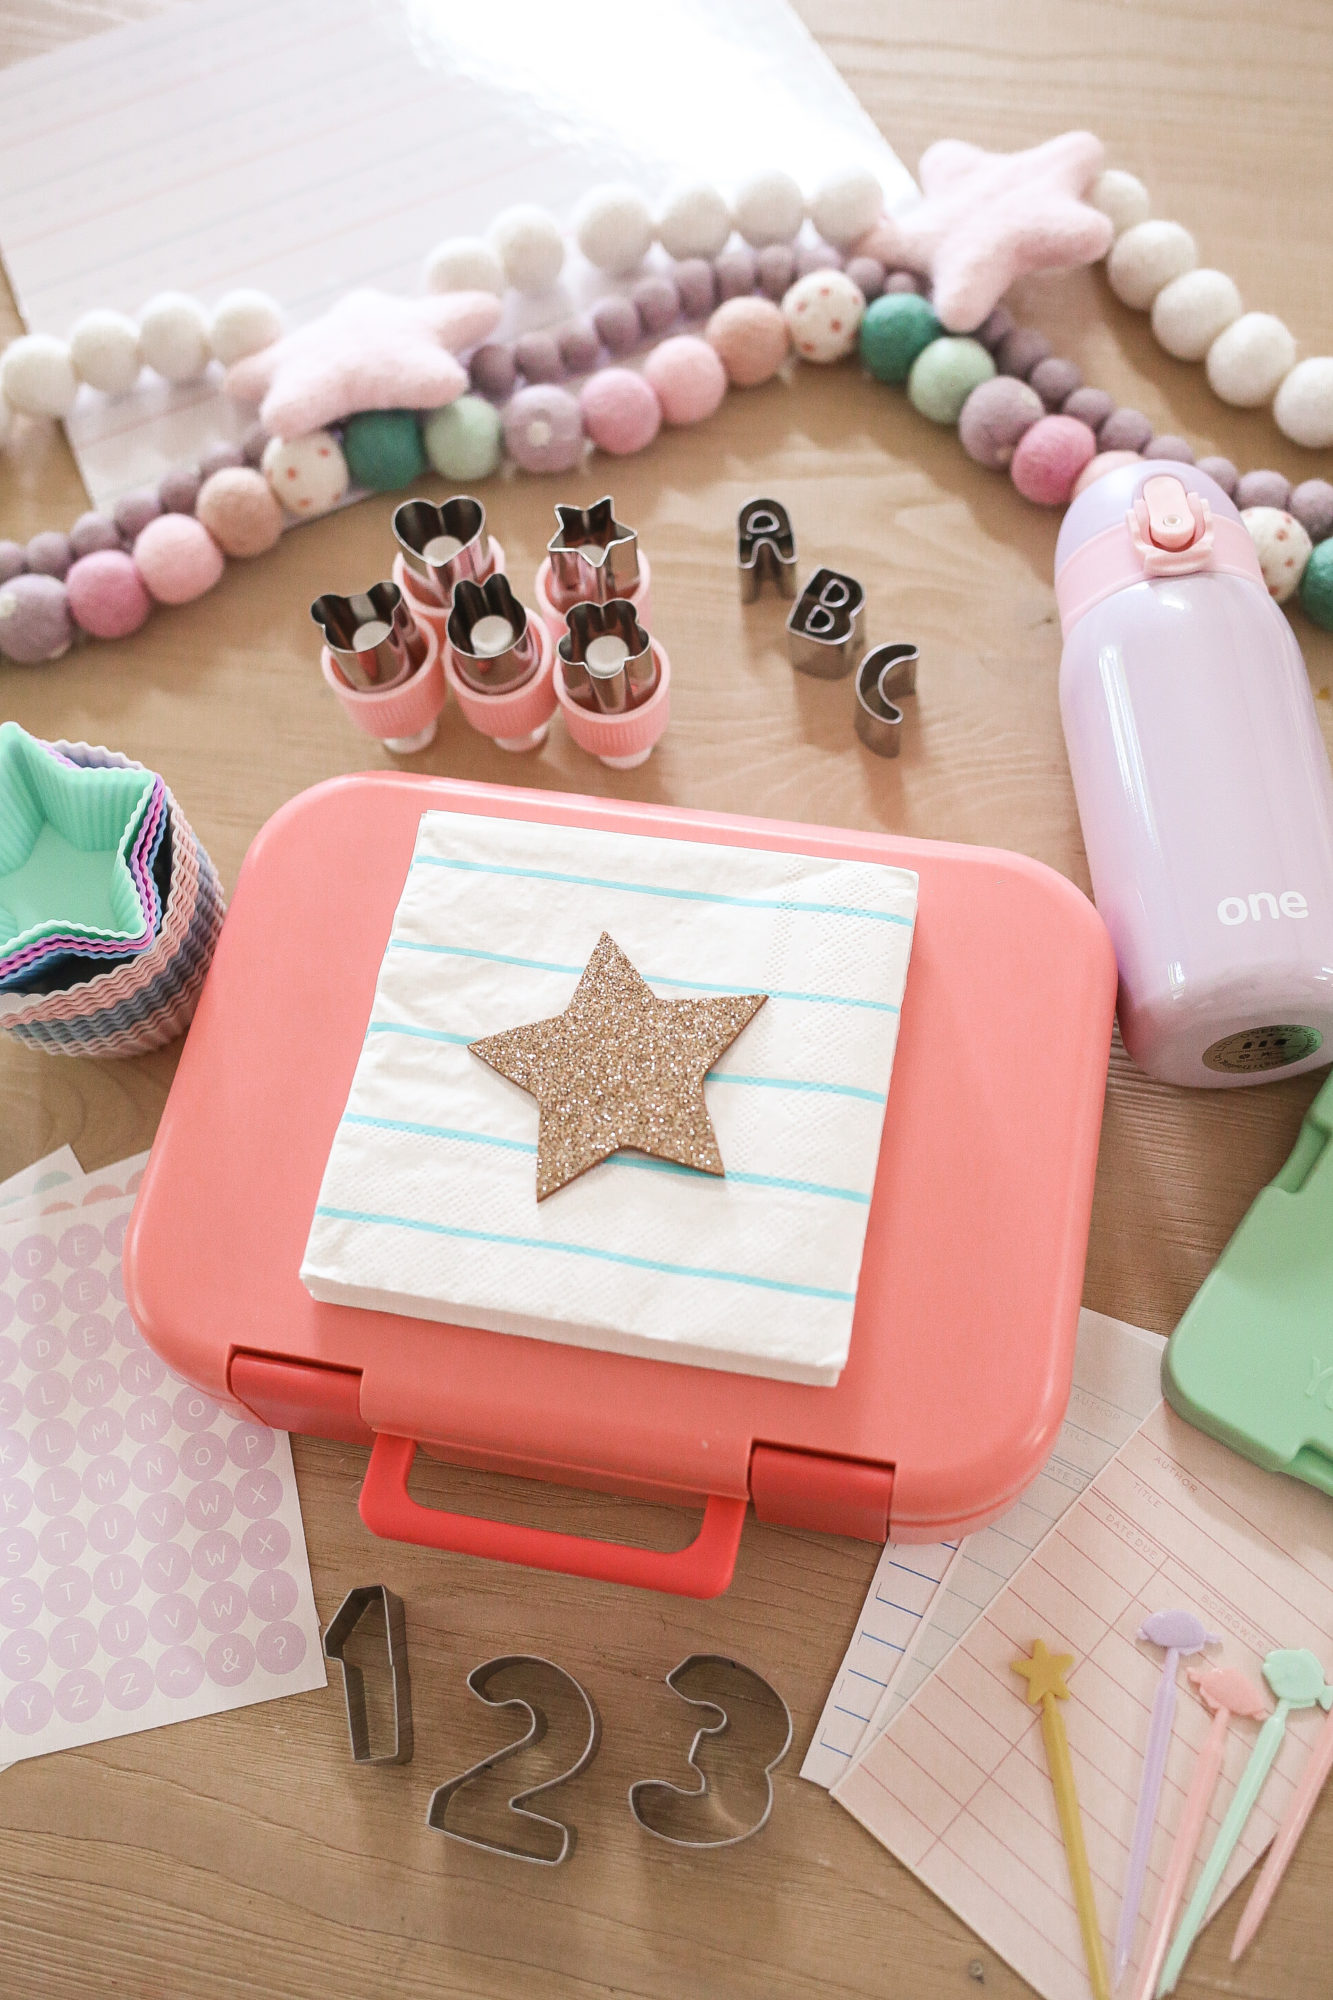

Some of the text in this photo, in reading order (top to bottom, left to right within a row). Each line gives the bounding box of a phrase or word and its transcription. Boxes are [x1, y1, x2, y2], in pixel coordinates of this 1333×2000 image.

[786, 564, 865, 645] B
[855, 641, 920, 725] C
[1216, 890, 1309, 926] one
[28, 1248, 42, 1267] D
[31, 1280, 93, 1313] D E
[36, 1326, 97, 1358] D E
[40, 1360, 152, 1405] L M N
[46, 1433, 61, 1453] L
[92, 1419, 110, 1441] M
[140, 1408, 157, 1431] N
[188, 1398, 205, 1417] O
[2, 1435, 258, 1513] K L M N O P
[1132, 1481, 1161, 1509] TITLE
[1153, 1454, 1199, 1493] AUTHOR
[6, 1484, 267, 1563] S T U V W X
[1105, 1513, 1160, 1560] DATE DUE
[11, 1534, 274, 1614] S T U V W X
[16, 1644, 31, 1666] S
[63, 1632, 80, 1655] T
[115, 1619, 130, 1642] U
[164, 1608, 180, 1629] V
[212, 1595, 233, 1618] W
[20, 1695, 35, 1720] Y
[69, 1684, 89, 1709] Z
[119, 1672, 139, 1696] Z
[222, 1647, 241, 1673] &
[273, 1635, 287, 1660] ?
[324, 1585, 793, 1865] 1 2 3
